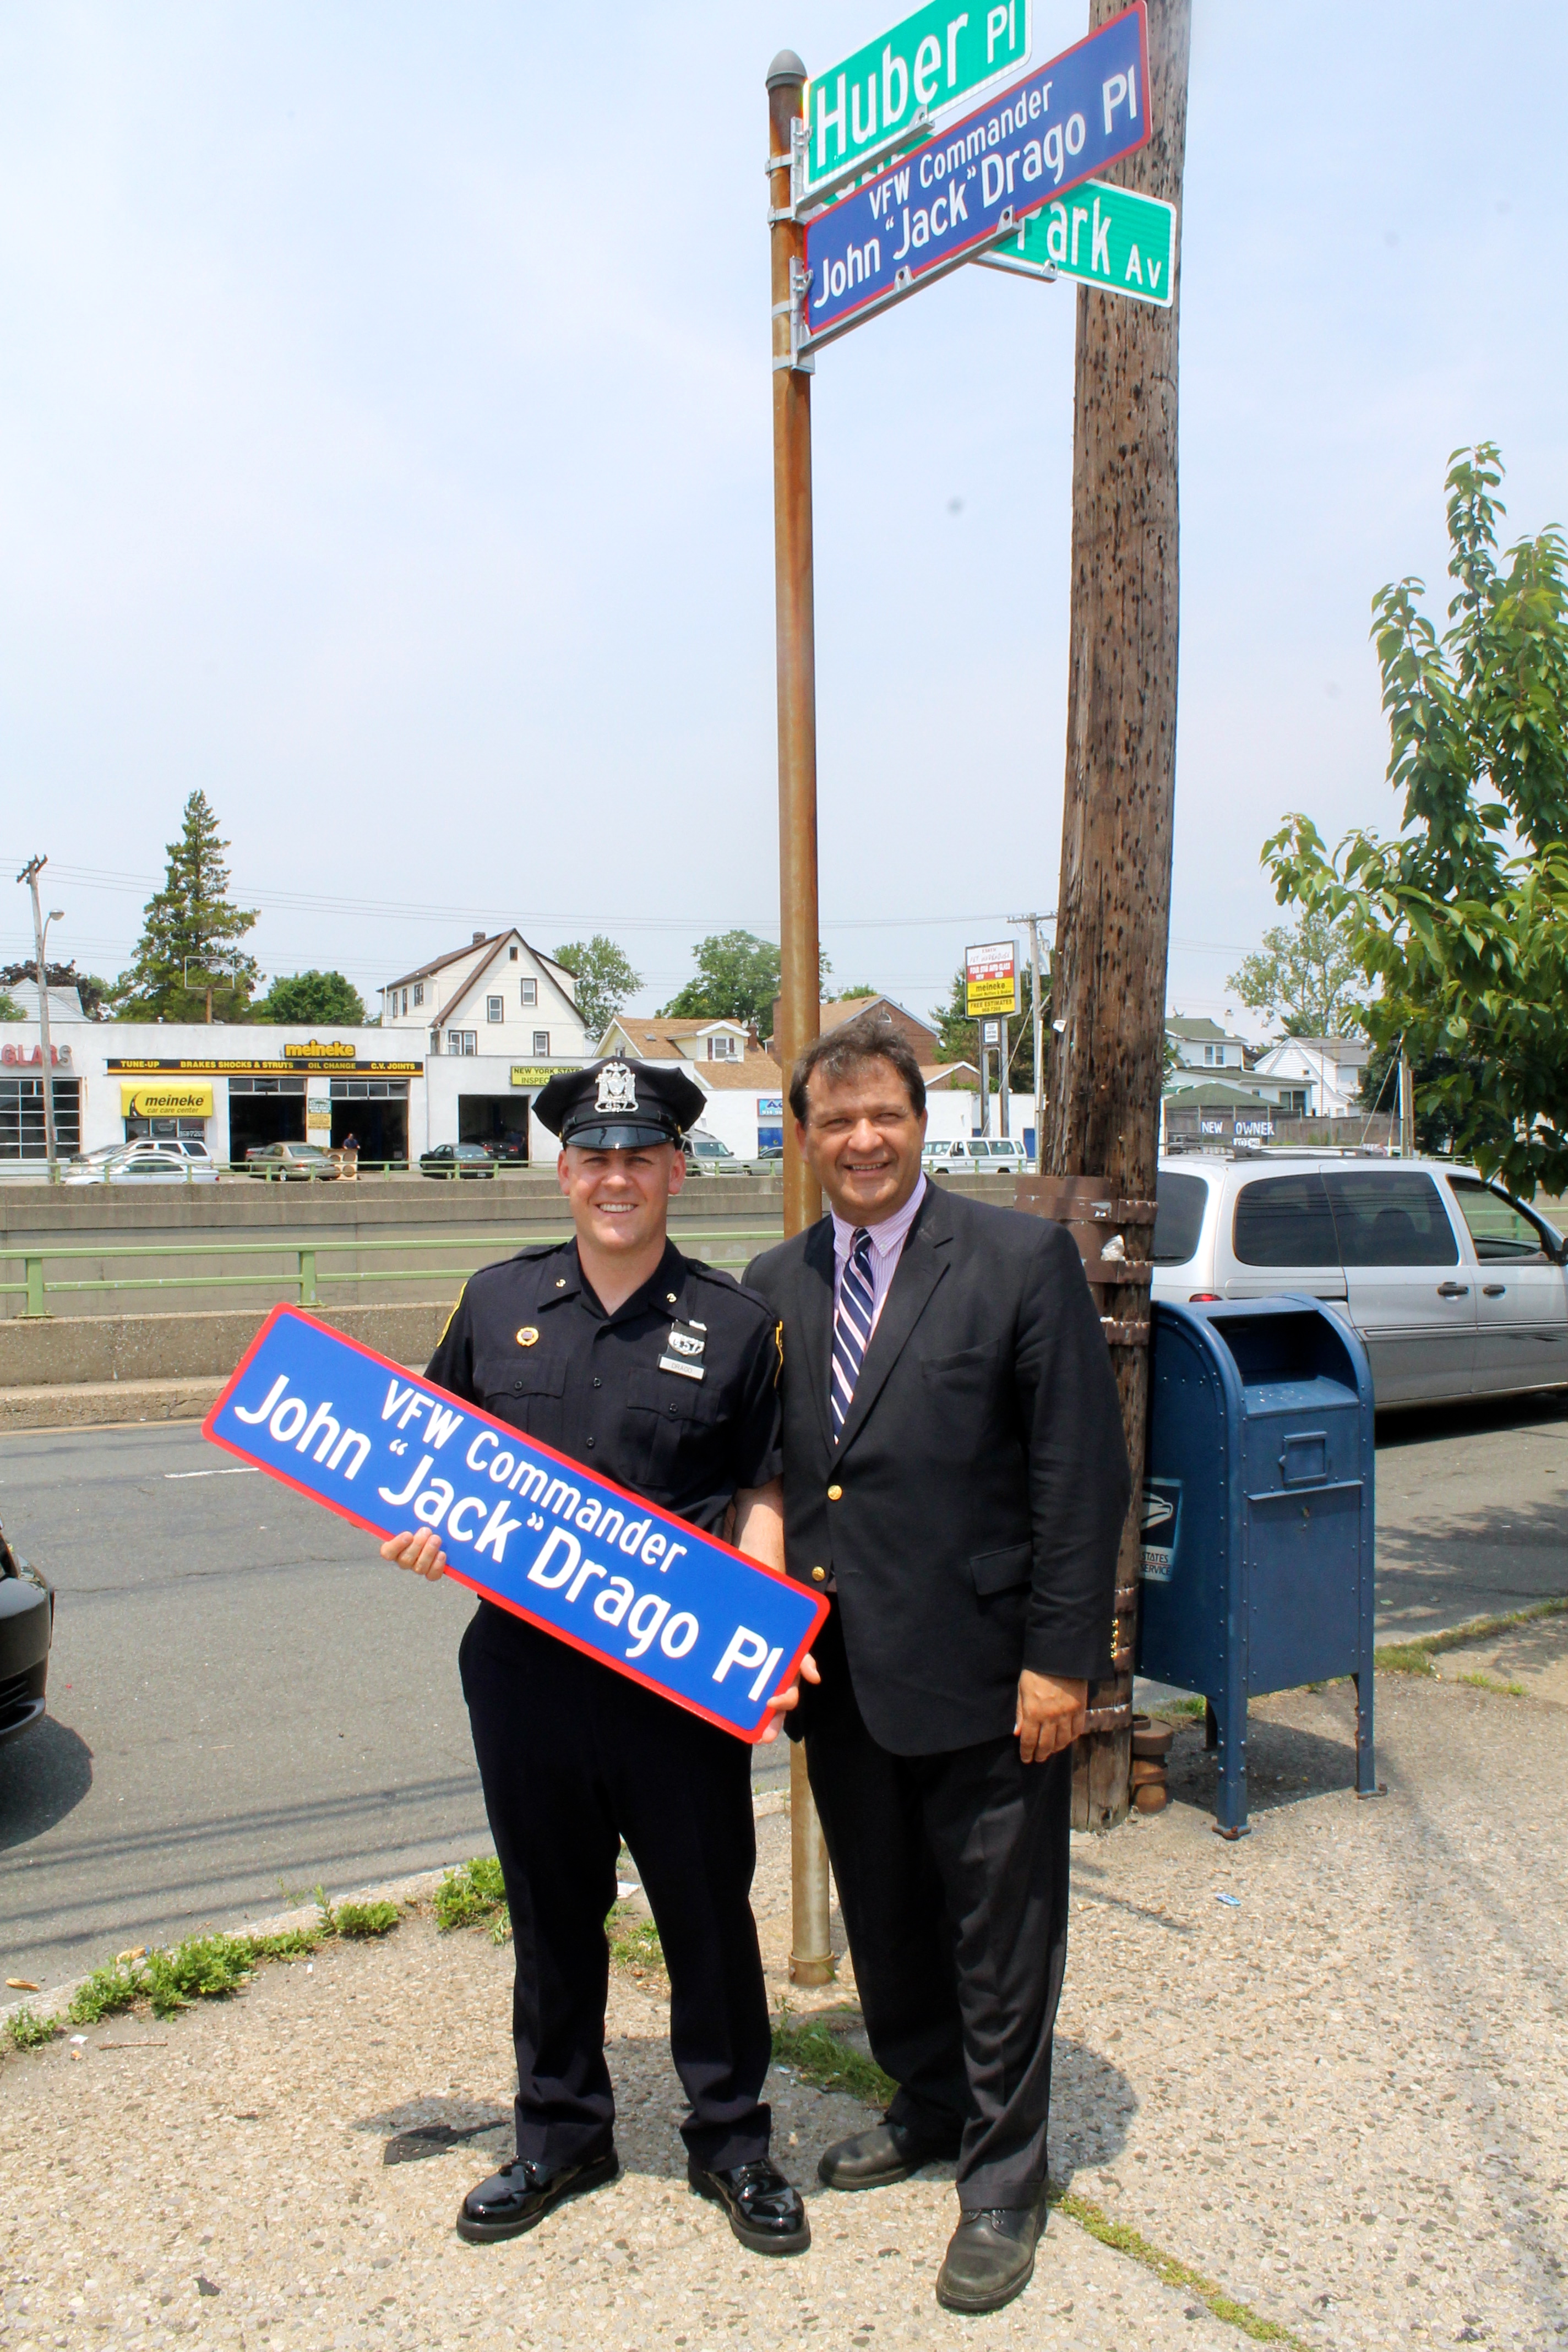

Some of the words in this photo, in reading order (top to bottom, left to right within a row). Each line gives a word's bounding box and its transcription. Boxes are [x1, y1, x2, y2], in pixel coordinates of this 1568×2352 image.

[816, 12, 968, 168] Huber
[987, 0, 1015, 64] Pl
[869, 166, 910, 220] VFW
[919, 81, 1053, 188] Commander
[814, 238, 880, 308] John
[981, 113, 1086, 208] Drago
[1102, 65, 1137, 135] Pl
[1125, 243, 1162, 290] Av
[976, 982, 1005, 992] meineke
[984, 999, 1012, 1007] ESTIMATES
[285, 1039, 355, 1058] meineke
[145, 1093, 204, 1107] meineke
[1201, 1121, 1223, 1134] NEW
[1235, 1121, 1275, 1135] OWNER
[671, 1363, 693, 1374] DRAGO
[381, 1379, 464, 1450] VFW
[466, 1431, 688, 1572] Commander
[234, 1374, 371, 1480] John
[527, 1526, 699, 1658] Drago
[712, 1625, 784, 1701] Pl
